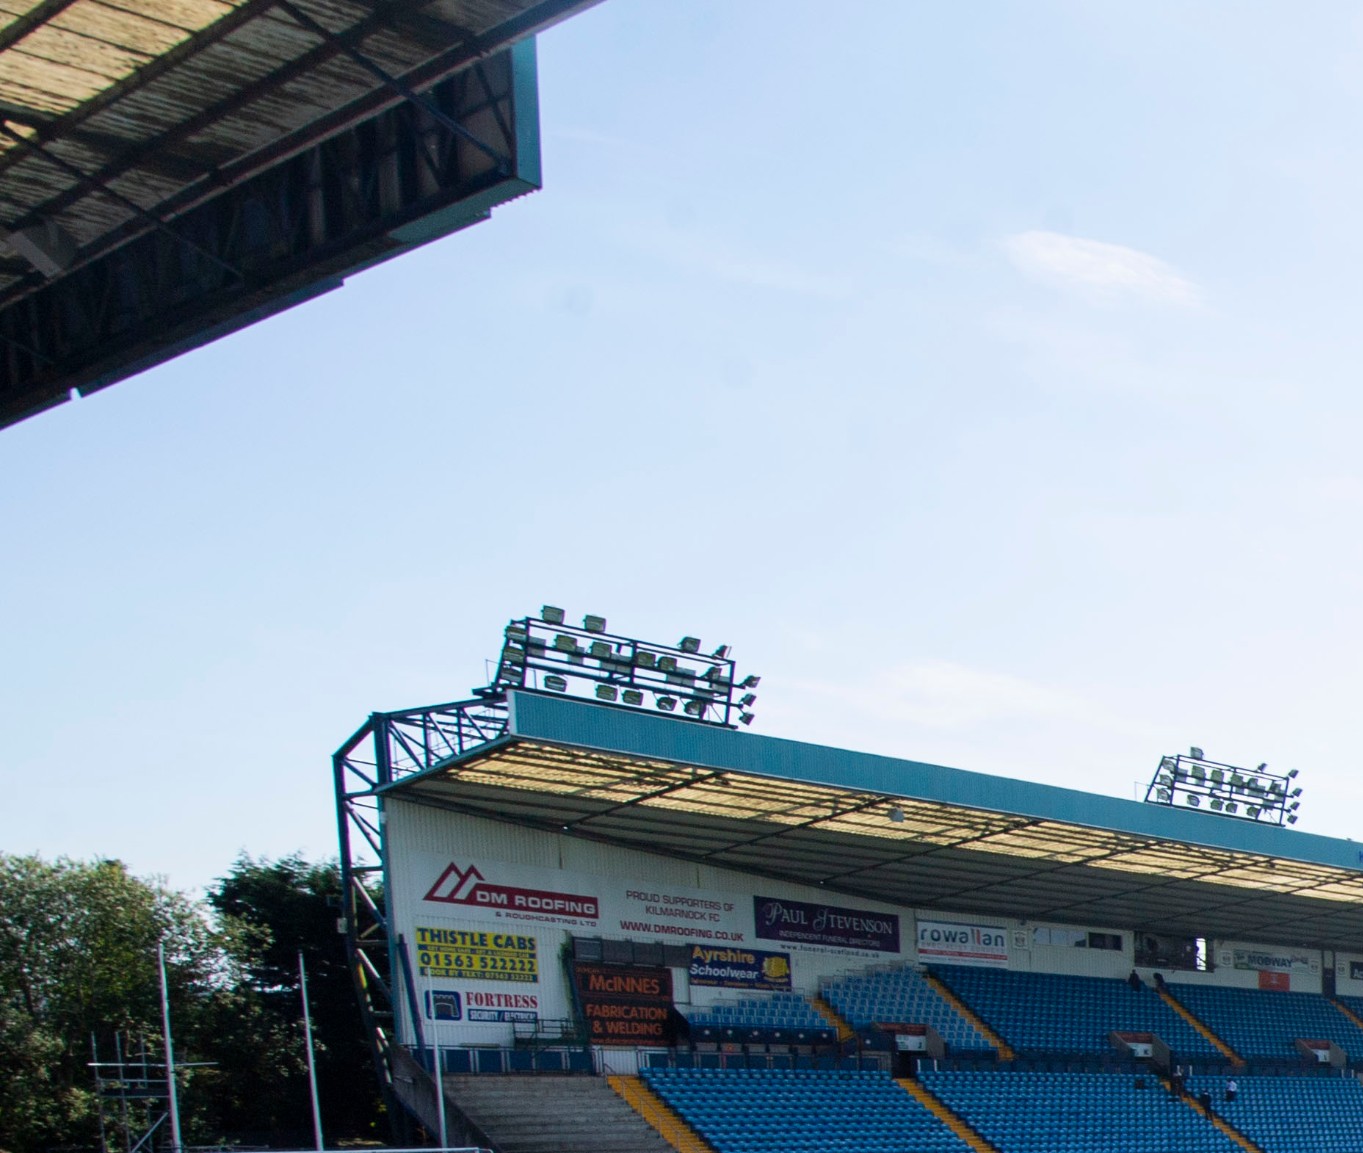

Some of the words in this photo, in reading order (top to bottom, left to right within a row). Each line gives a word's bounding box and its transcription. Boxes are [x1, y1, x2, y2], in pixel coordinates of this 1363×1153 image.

[476, 890, 507, 904] DM
[514, 894, 596, 914] ROOFING
[626, 890, 660, 904] PROUD
[662, 895, 722, 911] SUPPORTERS
[724, 902, 735, 912] OF
[505, 912, 577, 925] ROUGHCASTING
[645, 906, 707, 922] KILMARNOCK
[709, 912, 720, 922] FC
[762, 902, 808, 926] PAUL
[812, 908, 893, 934] STEVENSON
[418, 928, 488, 946] THISTLE
[493, 934, 536, 950] CABS
[620, 920, 744, 942] WWW.DMROOFING.CO.UK
[920, 927, 1004, 947] rowallan
[421, 952, 474, 967] 01563
[480, 957, 536, 971] 522222
[692, 945, 756, 965] Ayrshire
[689, 963, 759, 979] Schoolwear
[588, 975, 660, 994] McINNES
[466, 992, 538, 1009] FORTRESS
[586, 1003, 668, 1020] FABRICATION
[592, 1021, 602, 1033] &
[606, 1021, 663, 1035] WELDING
